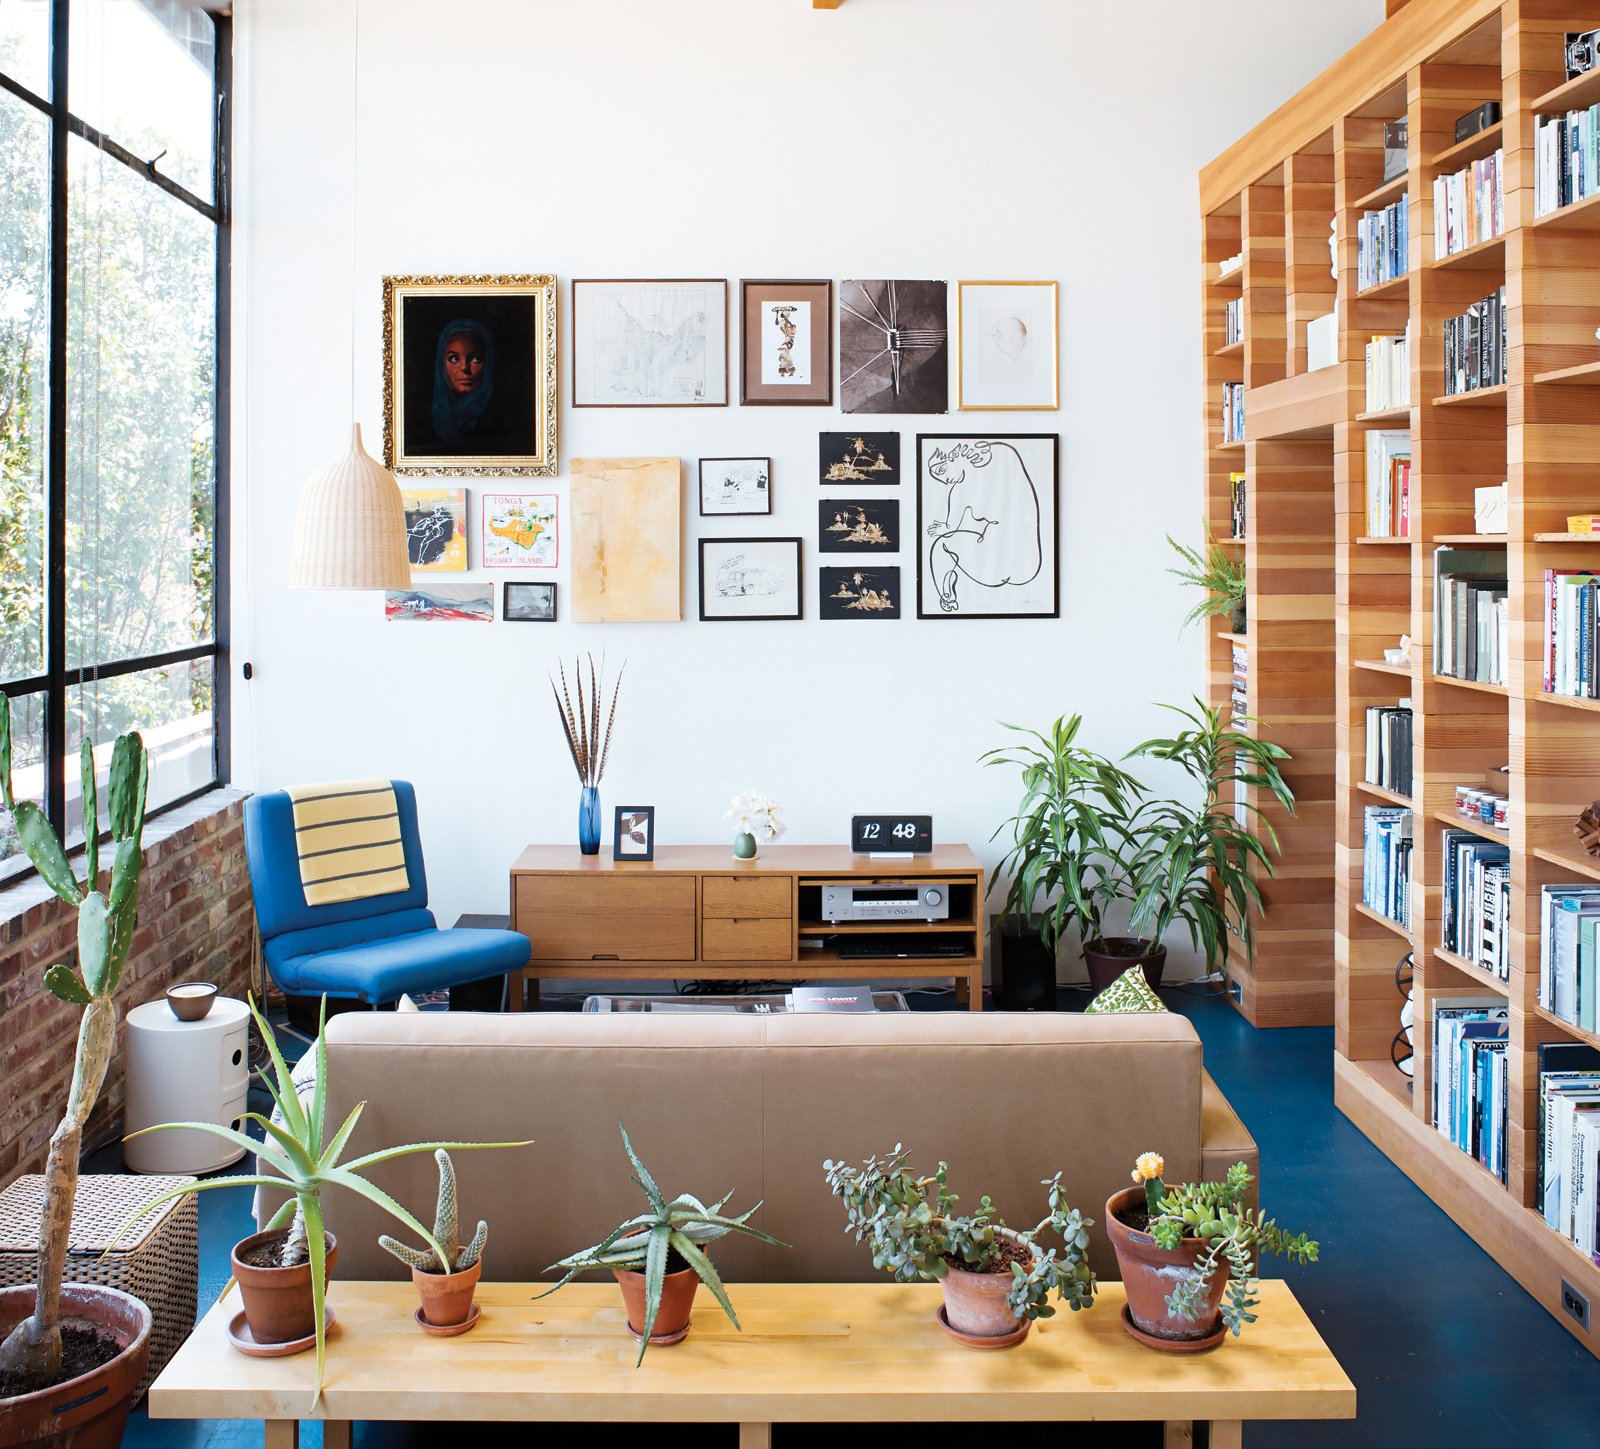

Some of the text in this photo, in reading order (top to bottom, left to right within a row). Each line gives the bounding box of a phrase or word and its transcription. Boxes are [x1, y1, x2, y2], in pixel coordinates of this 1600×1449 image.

[493, 497, 523, 505] TONGA
[862, 822, 916, 839] 12 48
